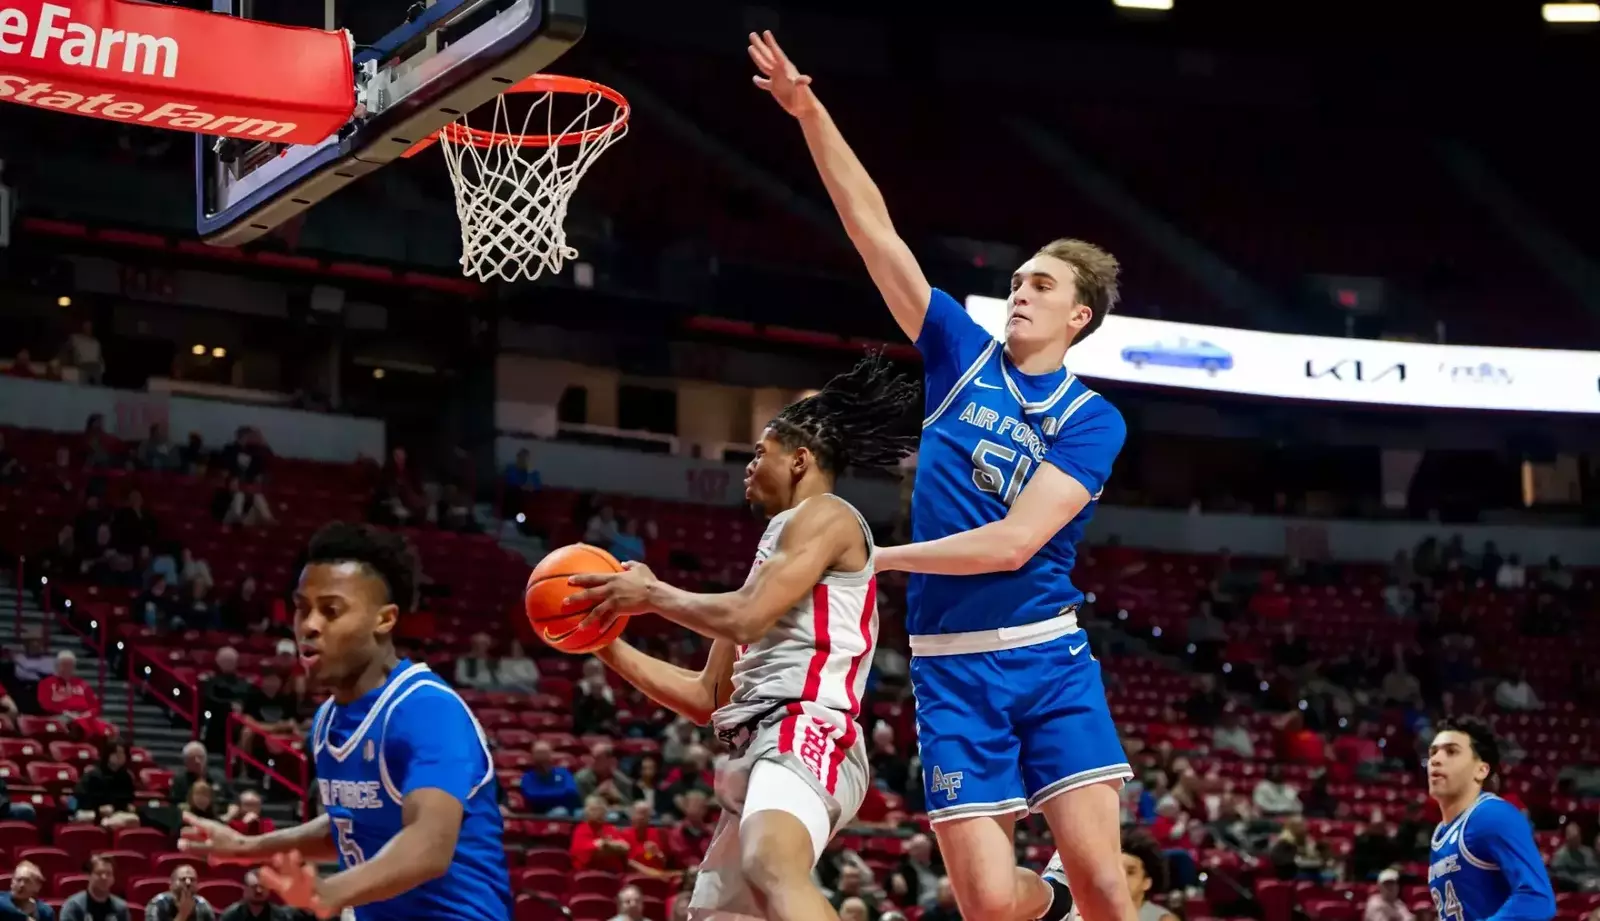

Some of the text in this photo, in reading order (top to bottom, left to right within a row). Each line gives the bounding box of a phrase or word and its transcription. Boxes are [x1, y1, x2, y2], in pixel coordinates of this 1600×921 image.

[31, 3, 179, 78] Farm
[0, 75, 297, 138] State Farm
[1306, 360, 1406, 383] KIA
[959, 402, 1048, 463] AIR FORC
[971, 439, 1032, 507] 51
[931, 765, 963, 800] AF
